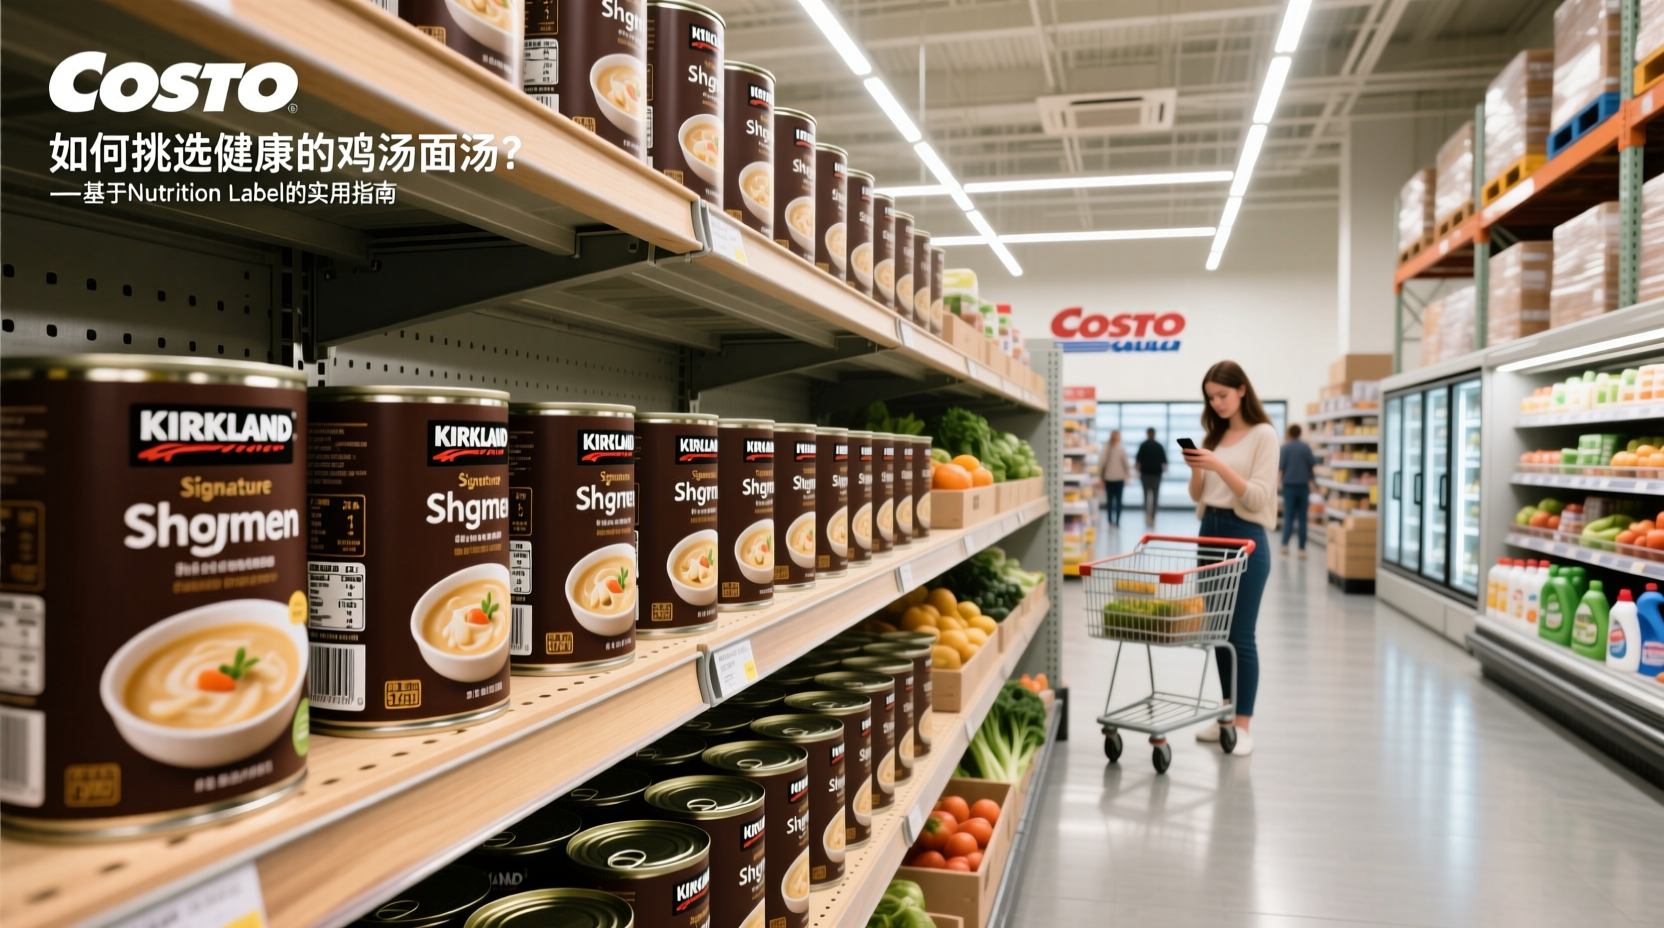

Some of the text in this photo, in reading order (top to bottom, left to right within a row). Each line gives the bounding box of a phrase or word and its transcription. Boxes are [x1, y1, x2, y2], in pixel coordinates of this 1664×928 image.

[1051, 307, 1186, 339] COSTO
[140, 410, 293, 443] KIRKLAND
[180, 476, 272, 502] Signature
